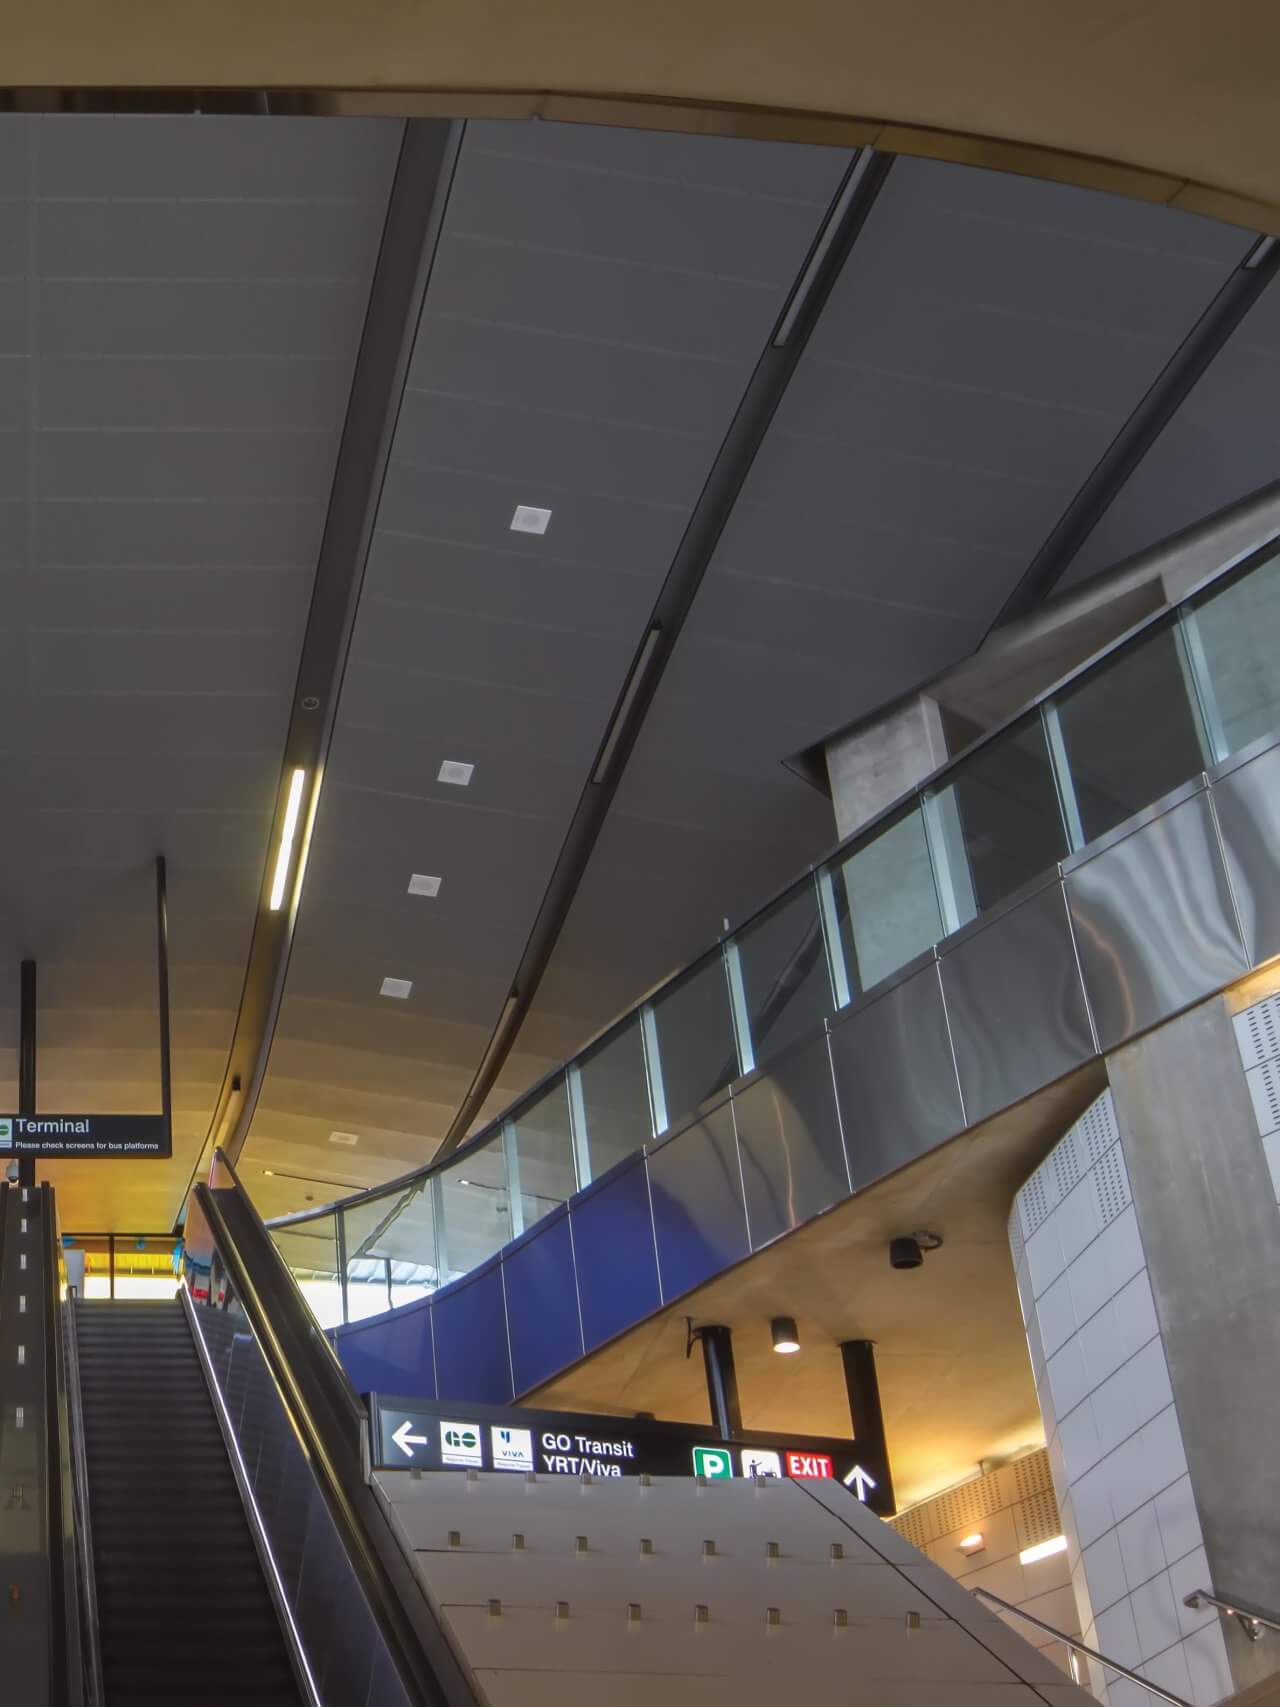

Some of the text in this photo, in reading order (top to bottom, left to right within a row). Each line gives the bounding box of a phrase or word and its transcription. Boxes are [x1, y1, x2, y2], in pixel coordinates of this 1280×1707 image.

[15, 1118, 89, 1133] Terminal
[15, 1141, 41, 1150] Please
[41, 1141, 64, 1150] check
[65, 1142, 95, 1150] screens
[96, 1141, 108, 1150] for
[108, 1141, 123, 1150] bus
[124, 1141, 159, 1152] platforms
[445, 1430, 477, 1449] GO
[541, 1432, 635, 1458] GO Transit
[501, 1449, 525, 1459] VIVA
[541, 1453, 622, 1478] YRT/Viva
[702, 1453, 725, 1479] P
[789, 1455, 829, 1478] EXIT
